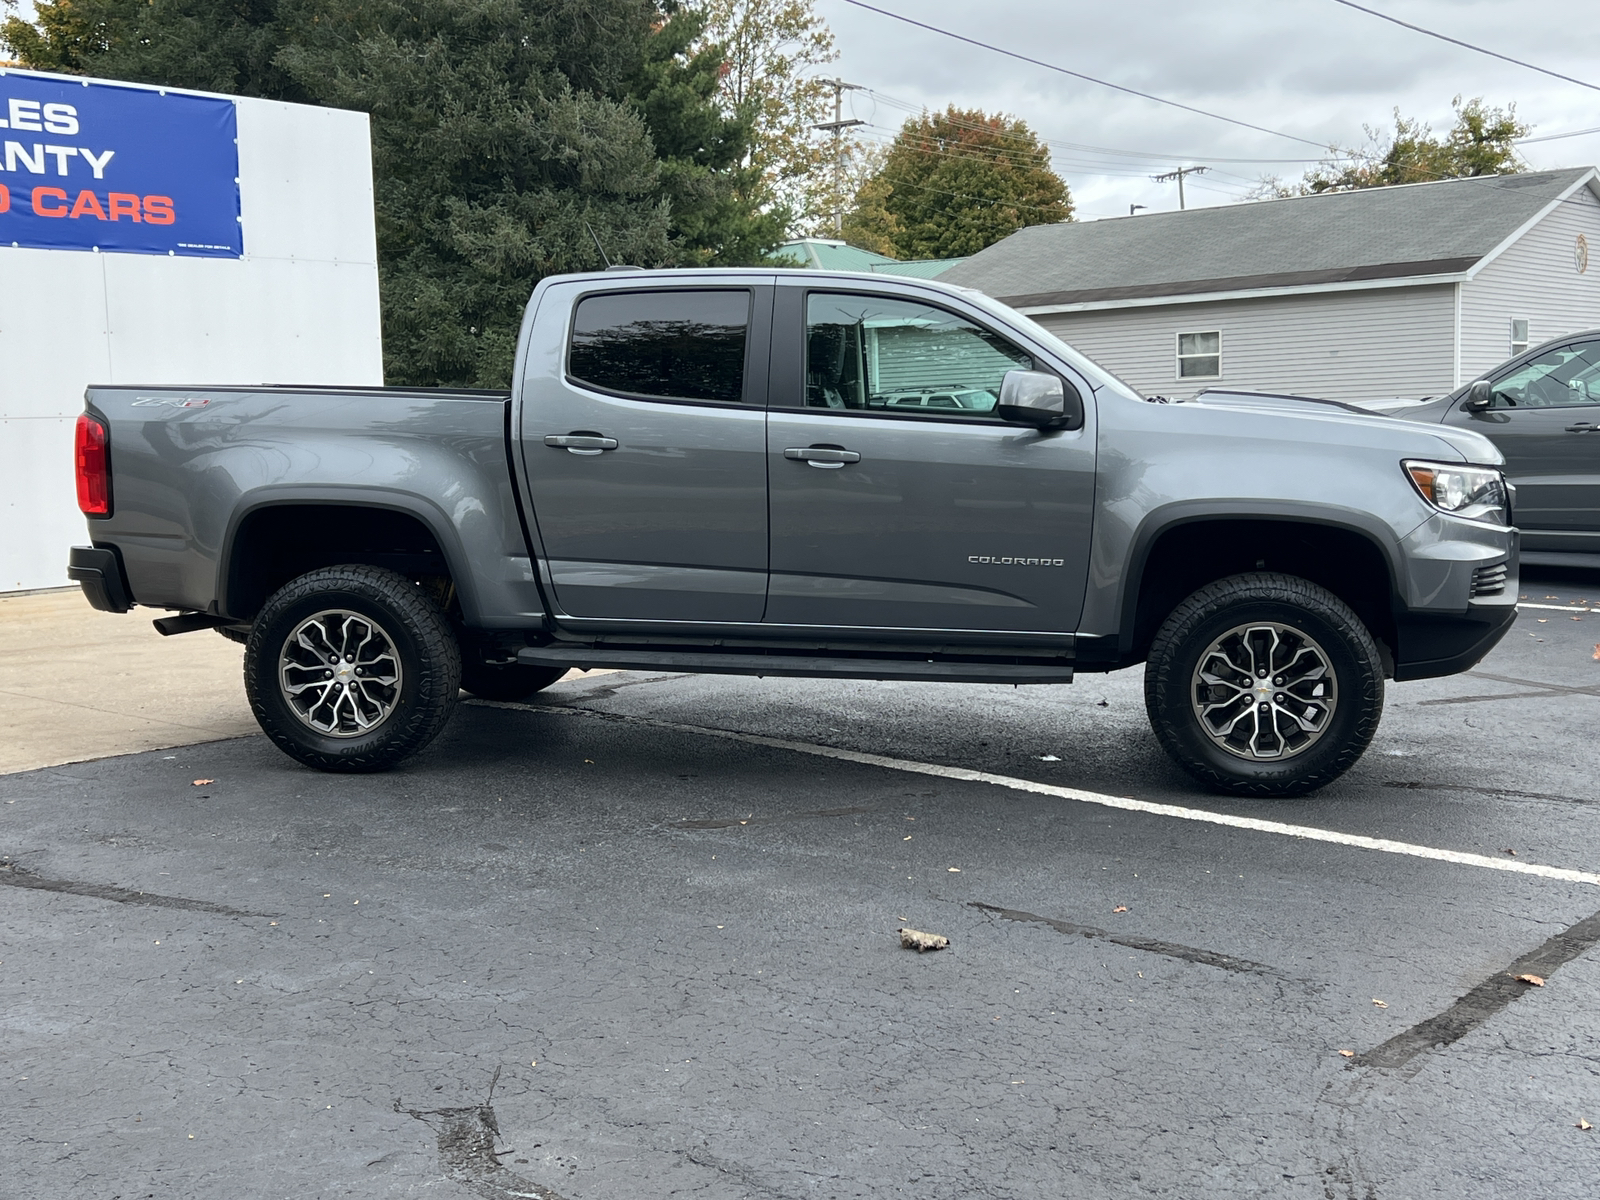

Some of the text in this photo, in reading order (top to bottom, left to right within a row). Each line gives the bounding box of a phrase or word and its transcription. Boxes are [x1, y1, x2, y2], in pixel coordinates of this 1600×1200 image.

[0, 98, 79, 135] ES
[0, 140, 115, 179] NTY
[31, 186, 175, 225] CARS
[968, 555, 1064, 566] COLORADO
